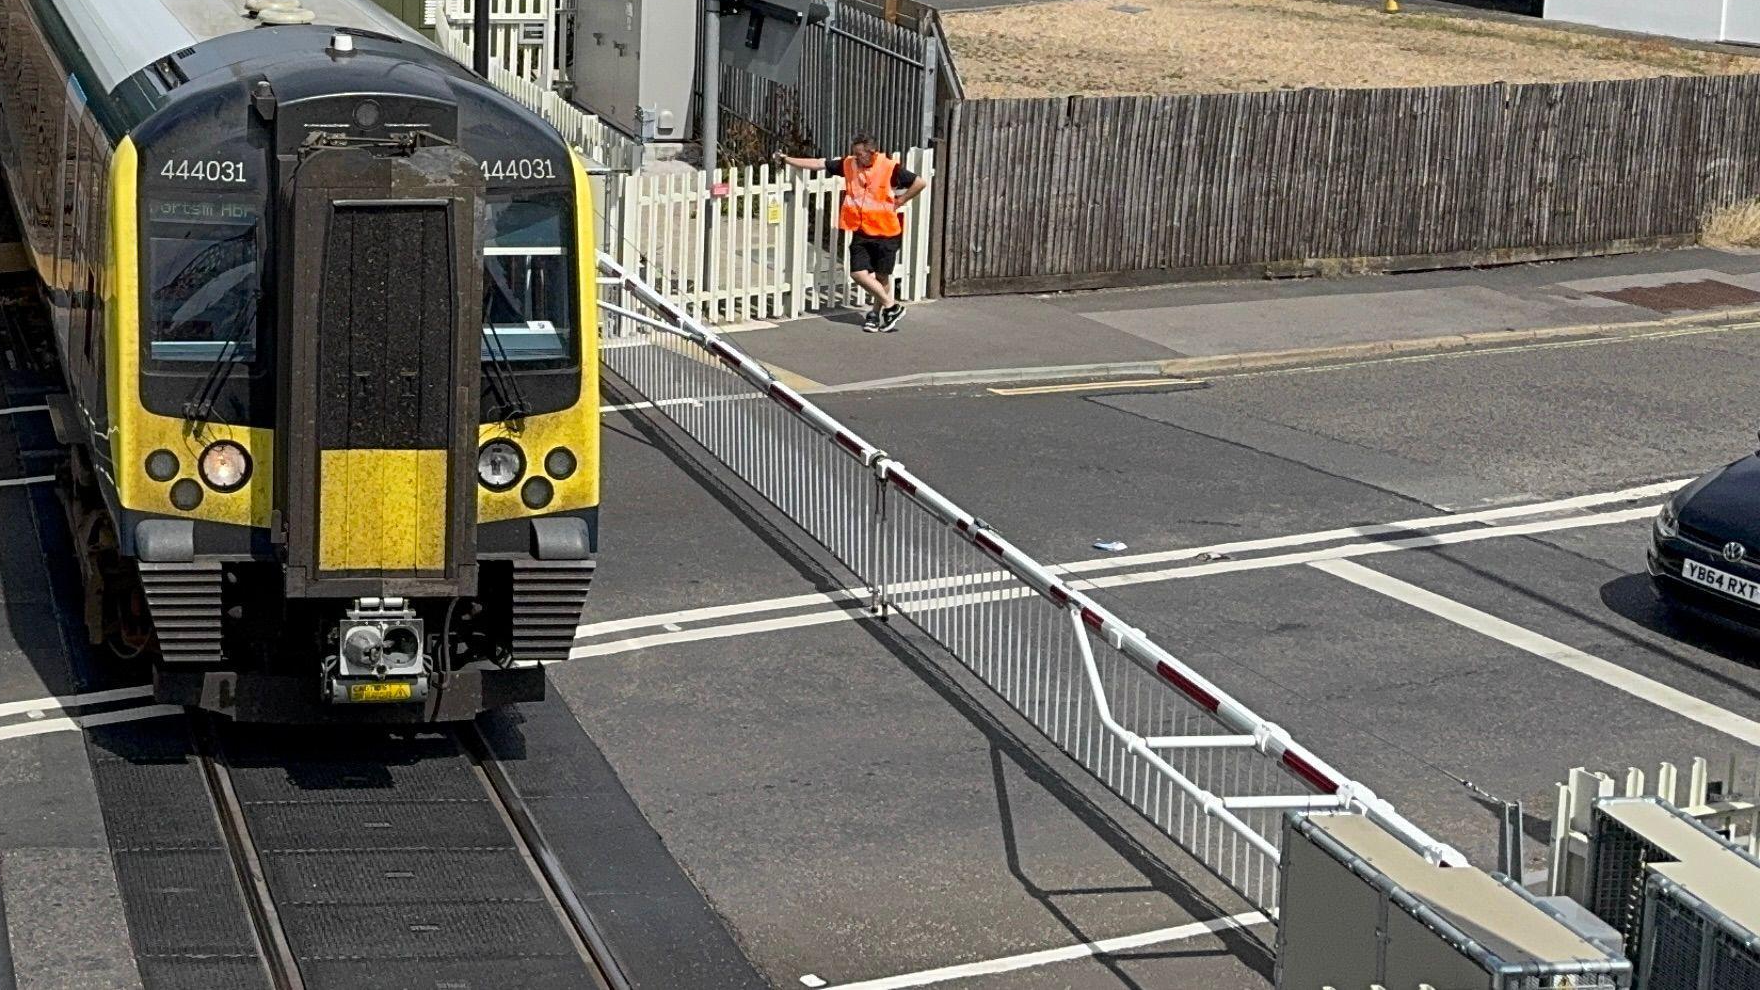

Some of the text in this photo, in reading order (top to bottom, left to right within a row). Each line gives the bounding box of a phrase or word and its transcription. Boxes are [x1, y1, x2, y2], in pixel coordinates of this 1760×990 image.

[161, 159, 246, 182] 444031
[1689, 562, 1758, 599] YB64 RXT
